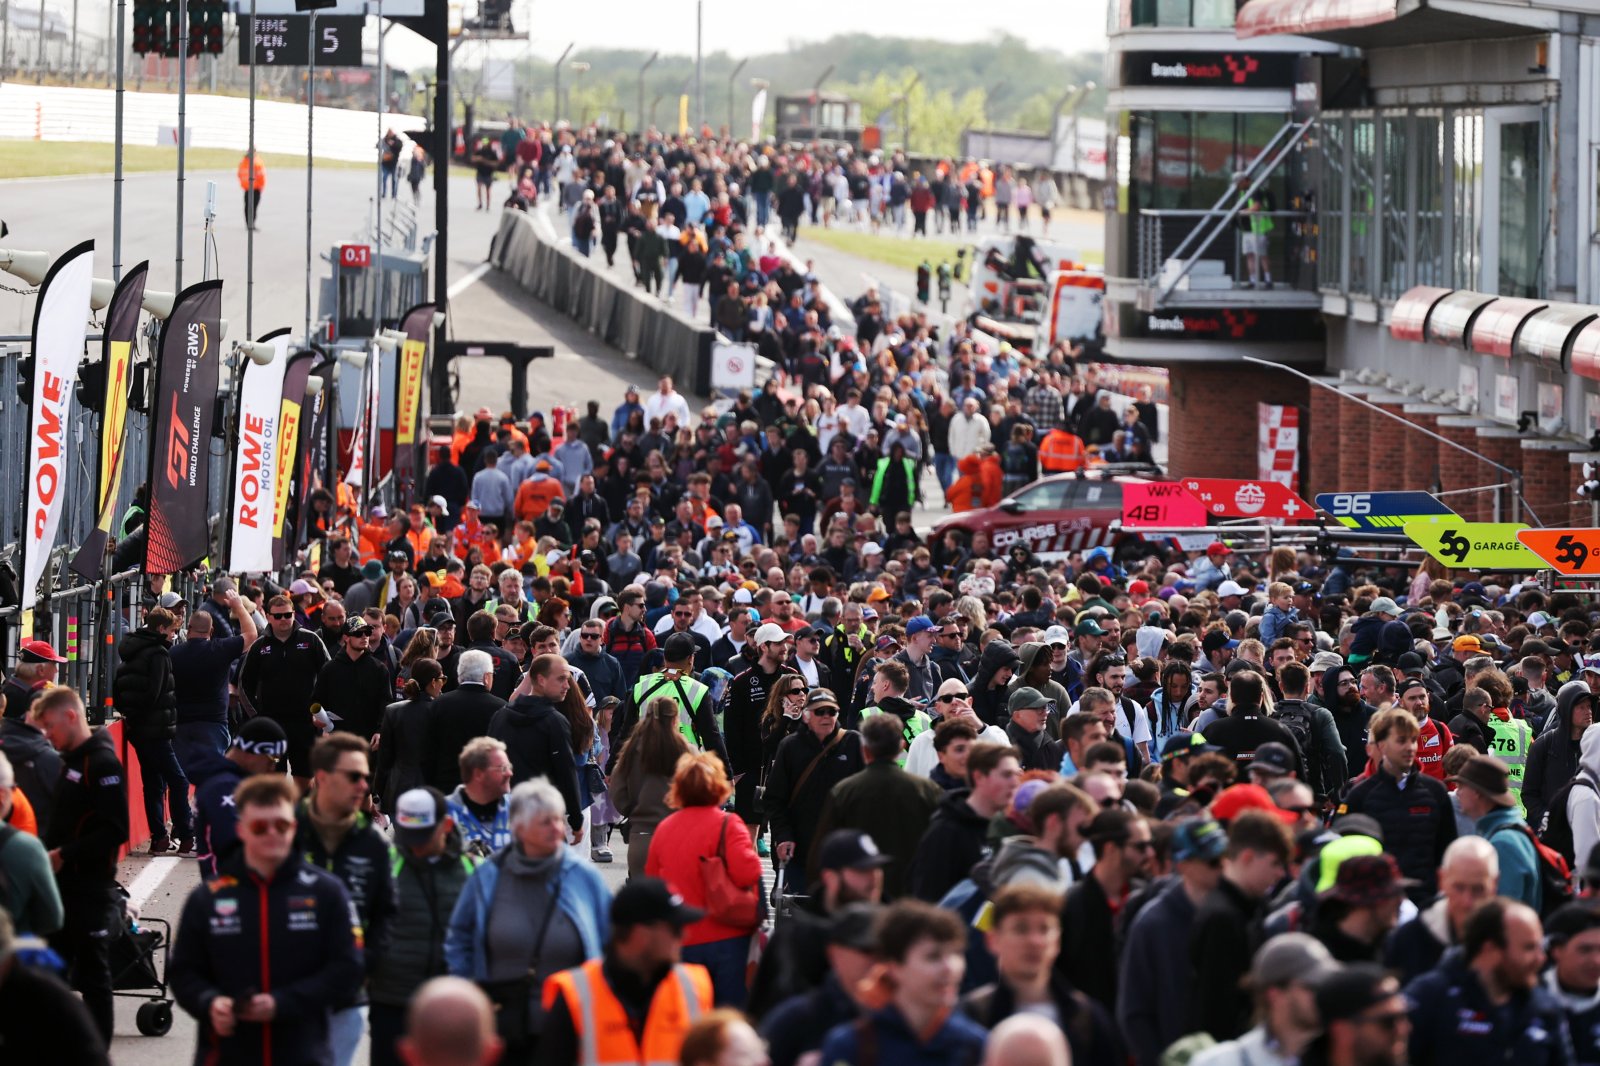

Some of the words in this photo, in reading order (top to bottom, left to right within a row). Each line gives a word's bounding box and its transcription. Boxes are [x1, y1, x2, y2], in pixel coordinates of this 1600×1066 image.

[322, 27, 339, 53] 5
[345, 248, 367, 262] 0.1
[187, 322, 199, 357] aws
[183, 358, 192, 393] POWERED
[191, 359, 198, 369] BY
[192, 406, 201, 456] CHALLENGE
[264, 417, 274, 439] OIL
[189, 456, 199, 487] WORLD
[239, 412, 264, 529] ROWE
[261, 441, 272, 490] MOTOR
[1187, 482, 1199, 490] 10
[1201, 493, 1212, 501] 14
[1333, 494, 1371, 515] 96
[993, 523, 1056, 548] COURSE
[1059, 517, 1092, 533] CAR
[1438, 529, 1471, 563] 59
[1473, 541, 1520, 551] GARAGE
[1555, 535, 1588, 570] 59
